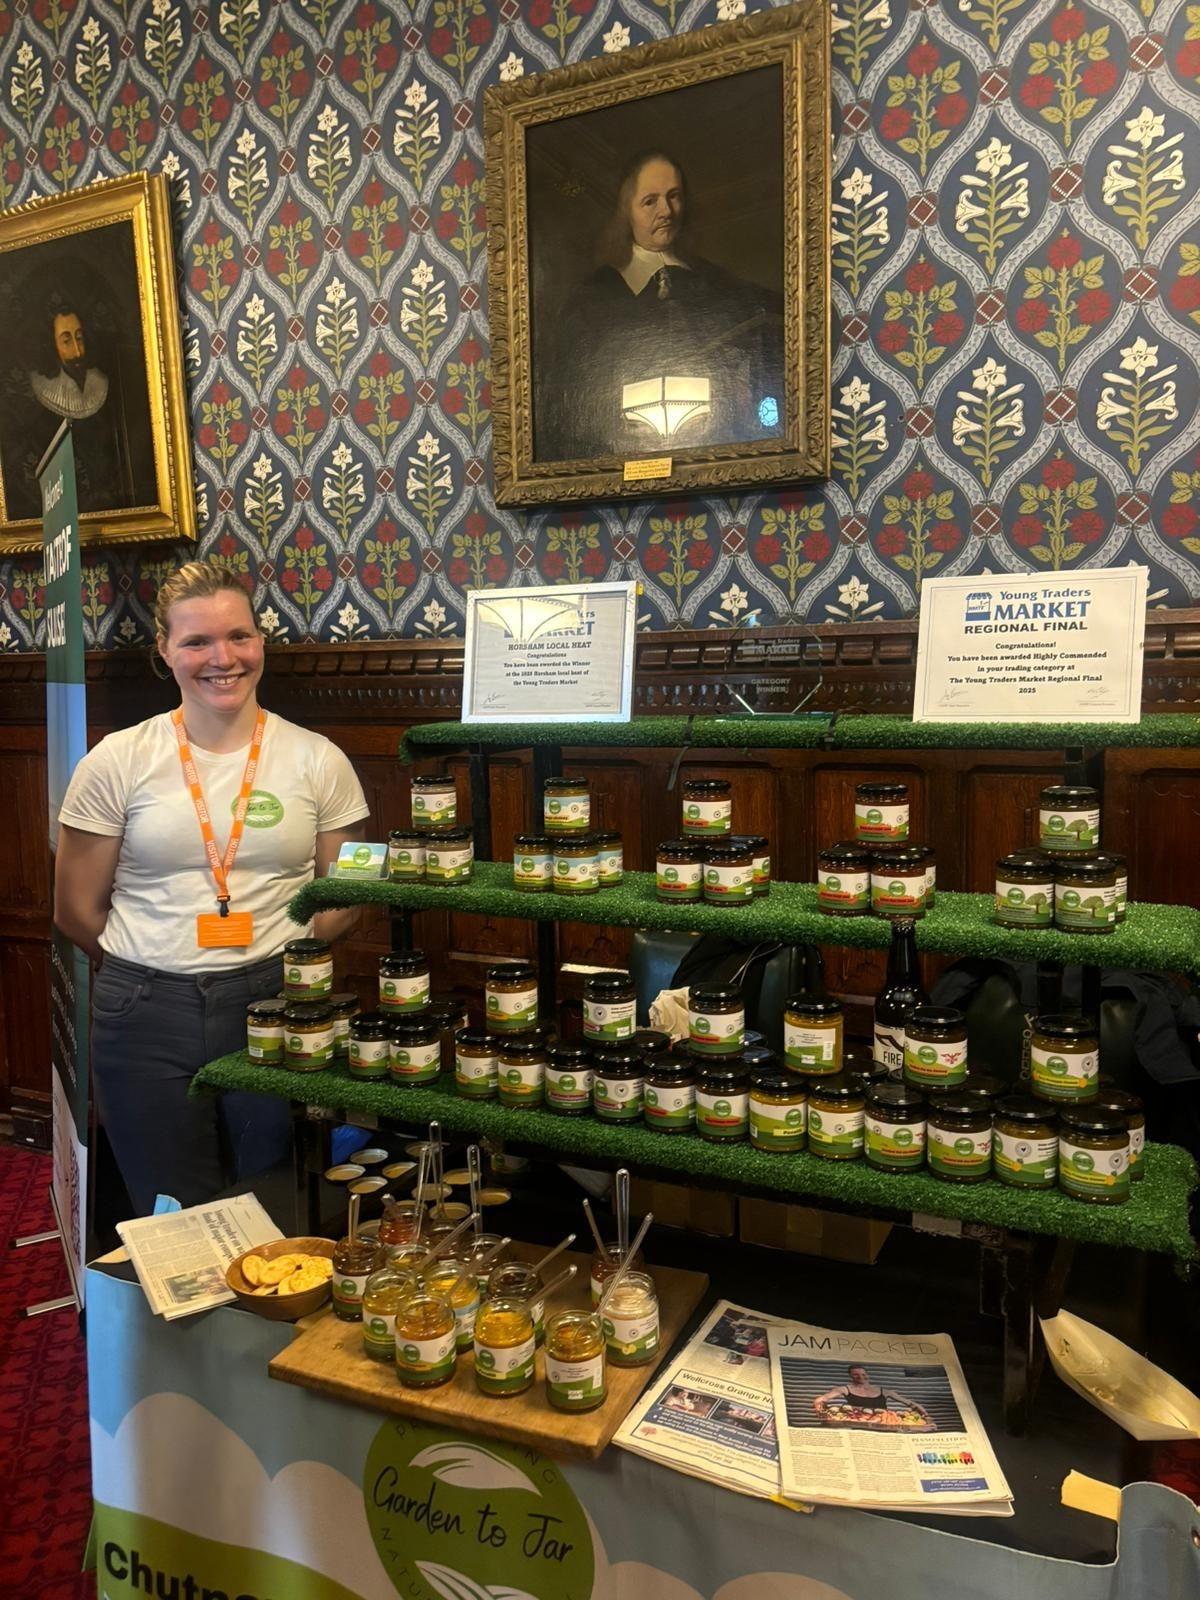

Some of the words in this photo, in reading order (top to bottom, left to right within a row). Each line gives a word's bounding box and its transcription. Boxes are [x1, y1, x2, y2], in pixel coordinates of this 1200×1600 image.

[1000, 591, 1038, 601] Young
[1041, 588, 1091, 598] Traders
[994, 601, 1091, 621] MARKET
[964, 623, 1038, 635] REGIONAL
[1043, 621, 1088, 632] FINAL
[508, 643, 544, 651] HORSHAM
[754, 644, 800, 655] MARKET
[995, 641, 1057, 650] Congratulations!
[1000, 653, 1032, 661] awarded
[1033, 653, 1058, 661] Highly
[1059, 651, 1107, 659] Commended
[1033, 664, 1066, 672] category
[1047, 675, 1081, 683] Regional
[193, 796, 210, 824] VISITOR
[205, 838, 221, 869] VISITOR
[226, 837, 239, 868] VISITOR
[778, 1334, 831, 1350] JAM
[837, 1337, 939, 1355] PACKED
[682, 1373, 725, 1390] Wellcross
[726, 1385, 761, 1401] Grange
[373, 1465, 465, 1535] Garden
[477, 1503, 507, 1548] to
[522, 1512, 574, 1563] Jar
